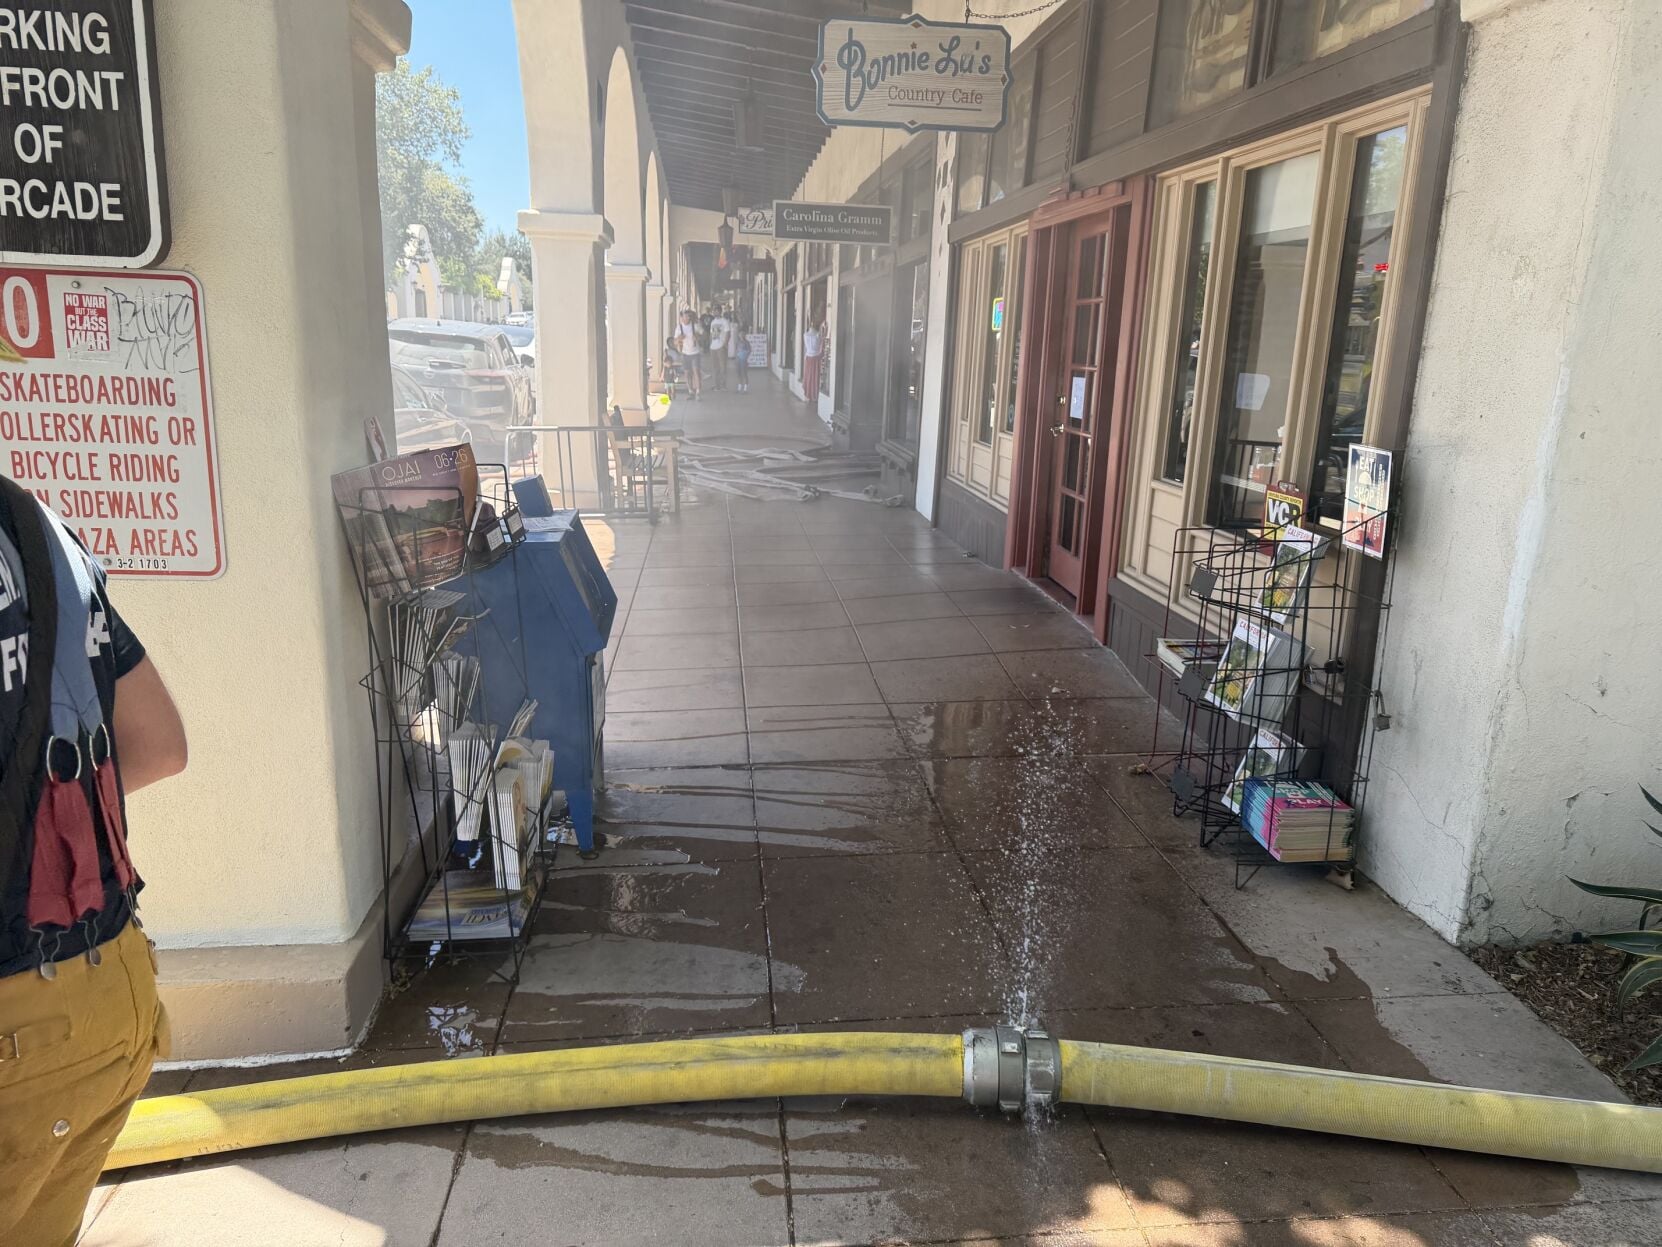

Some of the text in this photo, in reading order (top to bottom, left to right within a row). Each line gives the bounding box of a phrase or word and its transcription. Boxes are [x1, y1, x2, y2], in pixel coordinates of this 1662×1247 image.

[837, 27, 991, 111] Bonnie Lu's
[0, 66, 124, 110] FRONT
[888, 85, 983, 105] Country Cafe
[14, 122, 64, 163] OF
[0, 178, 124, 221] RCADE
[838, 211, 882, 225] Gramm
[65, 293, 106, 308] NO WAR
[87, 308, 98, 317] THE
[66, 314, 107, 332] CLASS
[0, 372, 177, 407] SKATEBOARDING
[0, 411, 196, 446] OLLERSKATING OR
[11, 450, 180, 483] BICYCLE RIDING
[382, 460, 421, 481] OJAI
[59, 489, 179, 520] SIDEWALKS
[78, 527, 199, 557] AZA AREAS
[139, 558, 168, 570] 1703
